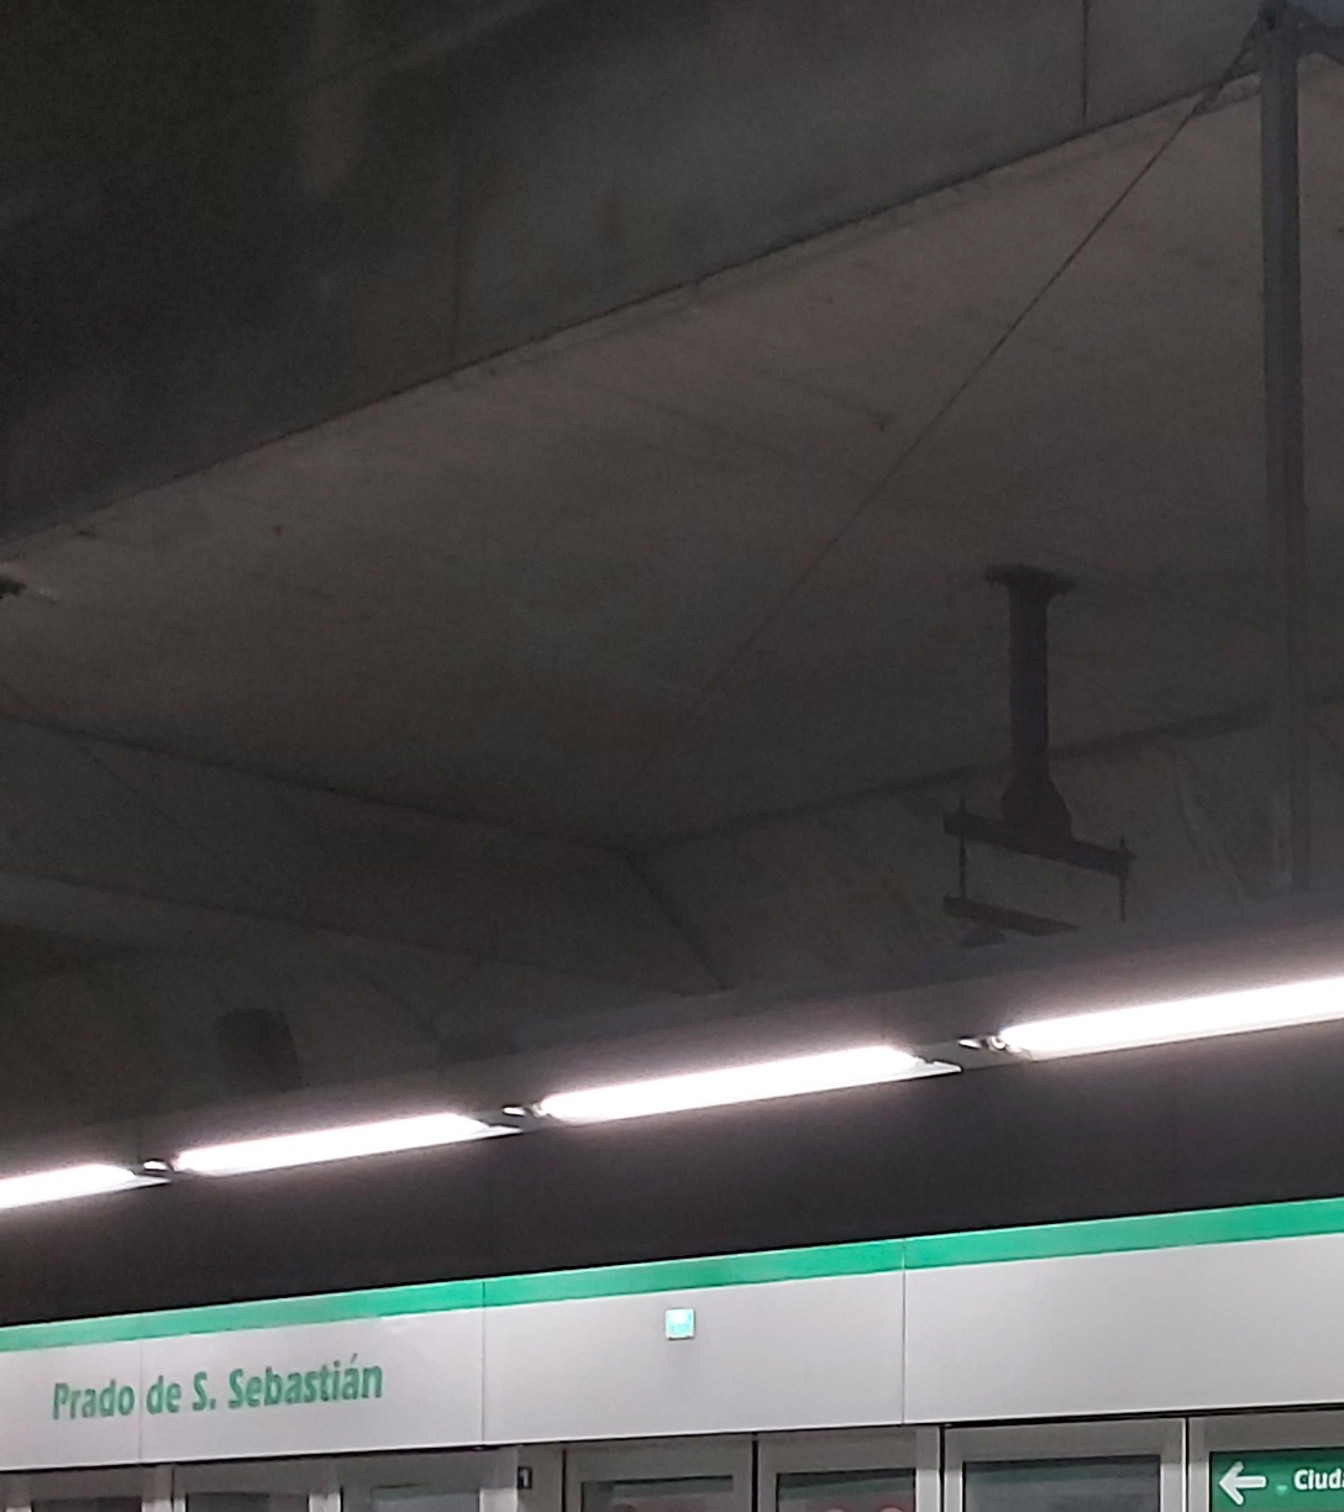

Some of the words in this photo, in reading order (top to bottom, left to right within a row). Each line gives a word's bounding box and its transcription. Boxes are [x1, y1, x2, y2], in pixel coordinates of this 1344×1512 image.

[53, 1378, 136, 1420] Prado
[146, 1374, 182, 1415] de
[191, 1371, 216, 1411] S.
[228, 1353, 383, 1409] Sebastián
